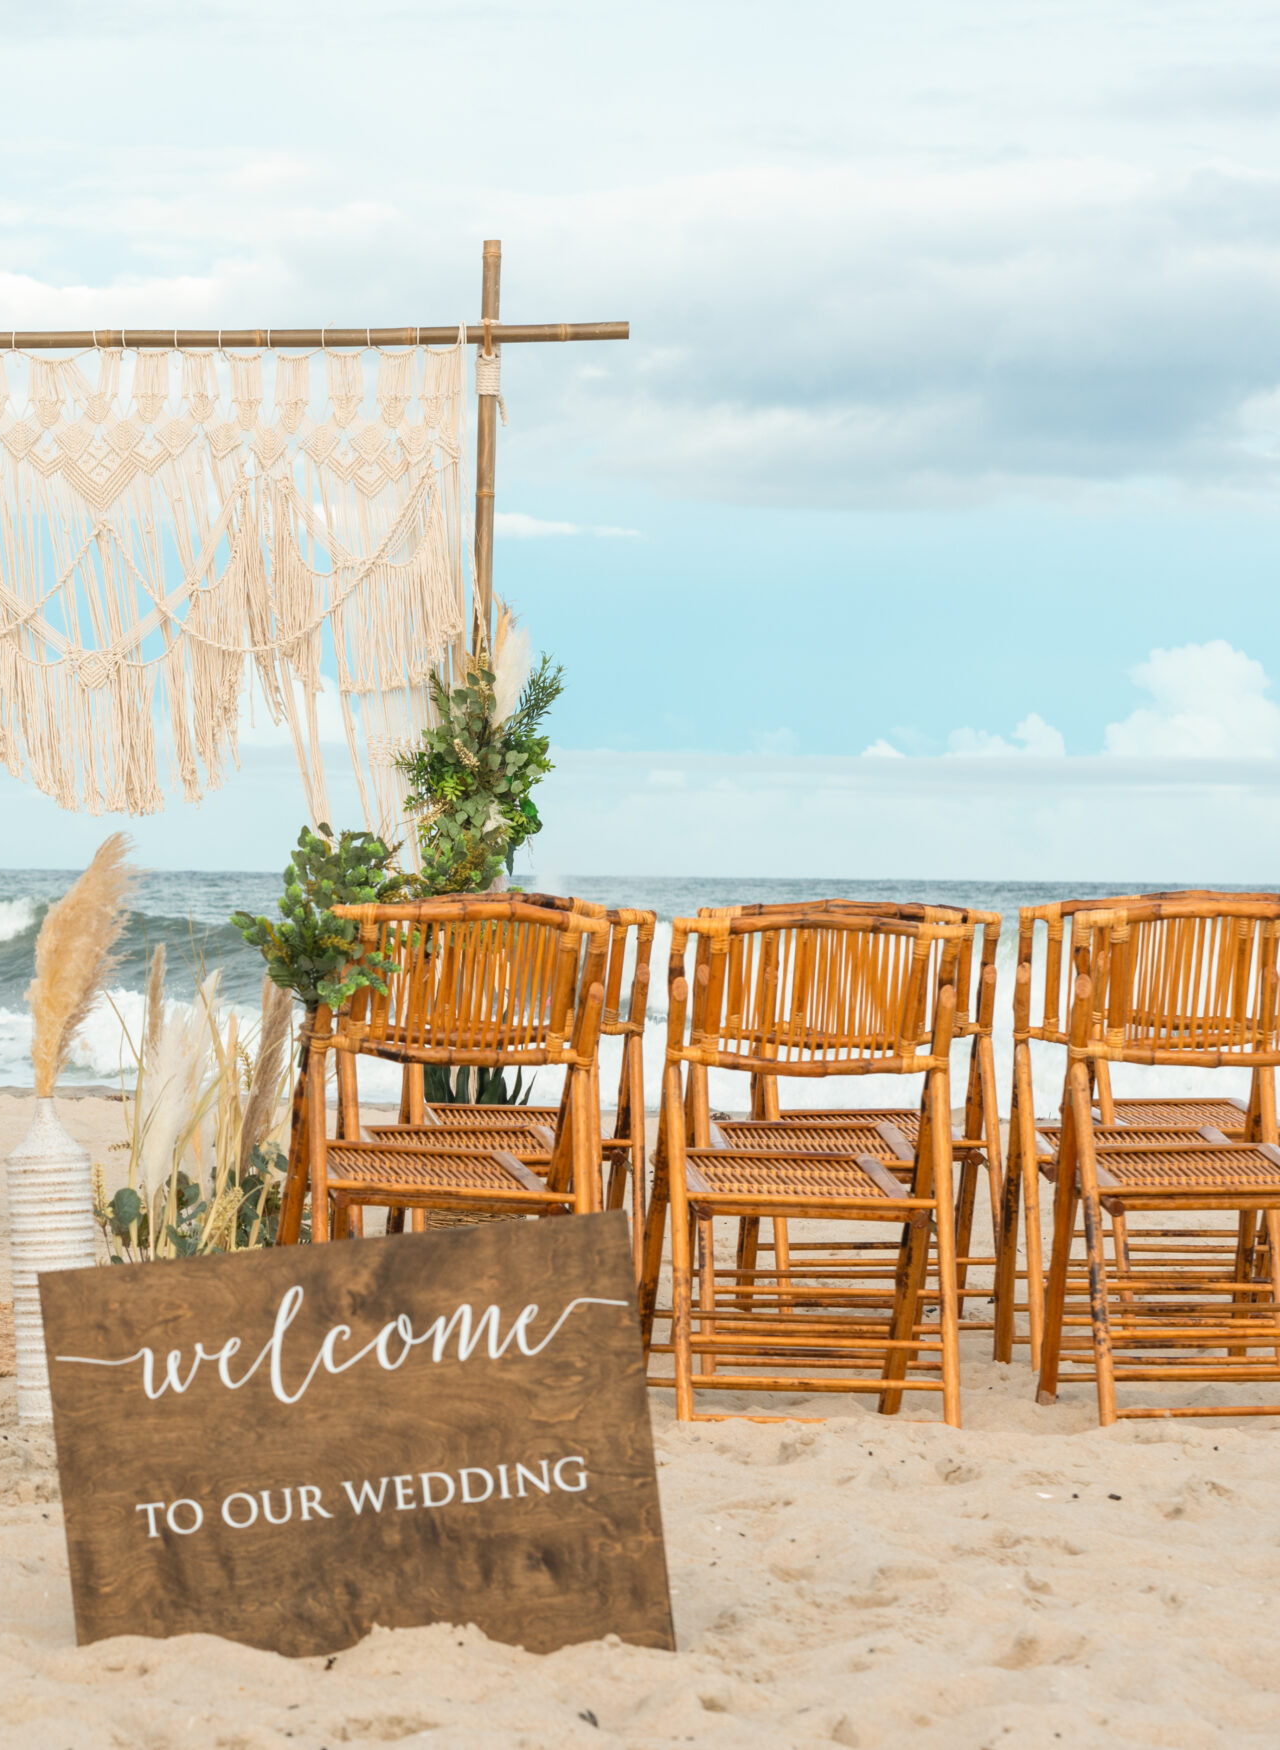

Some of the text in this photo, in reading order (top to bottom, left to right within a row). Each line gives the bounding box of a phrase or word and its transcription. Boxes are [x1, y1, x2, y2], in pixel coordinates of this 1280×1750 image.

[56, 1285, 629, 1404] welcome
[135, 1456, 588, 1539] TO OUR WEDDING
